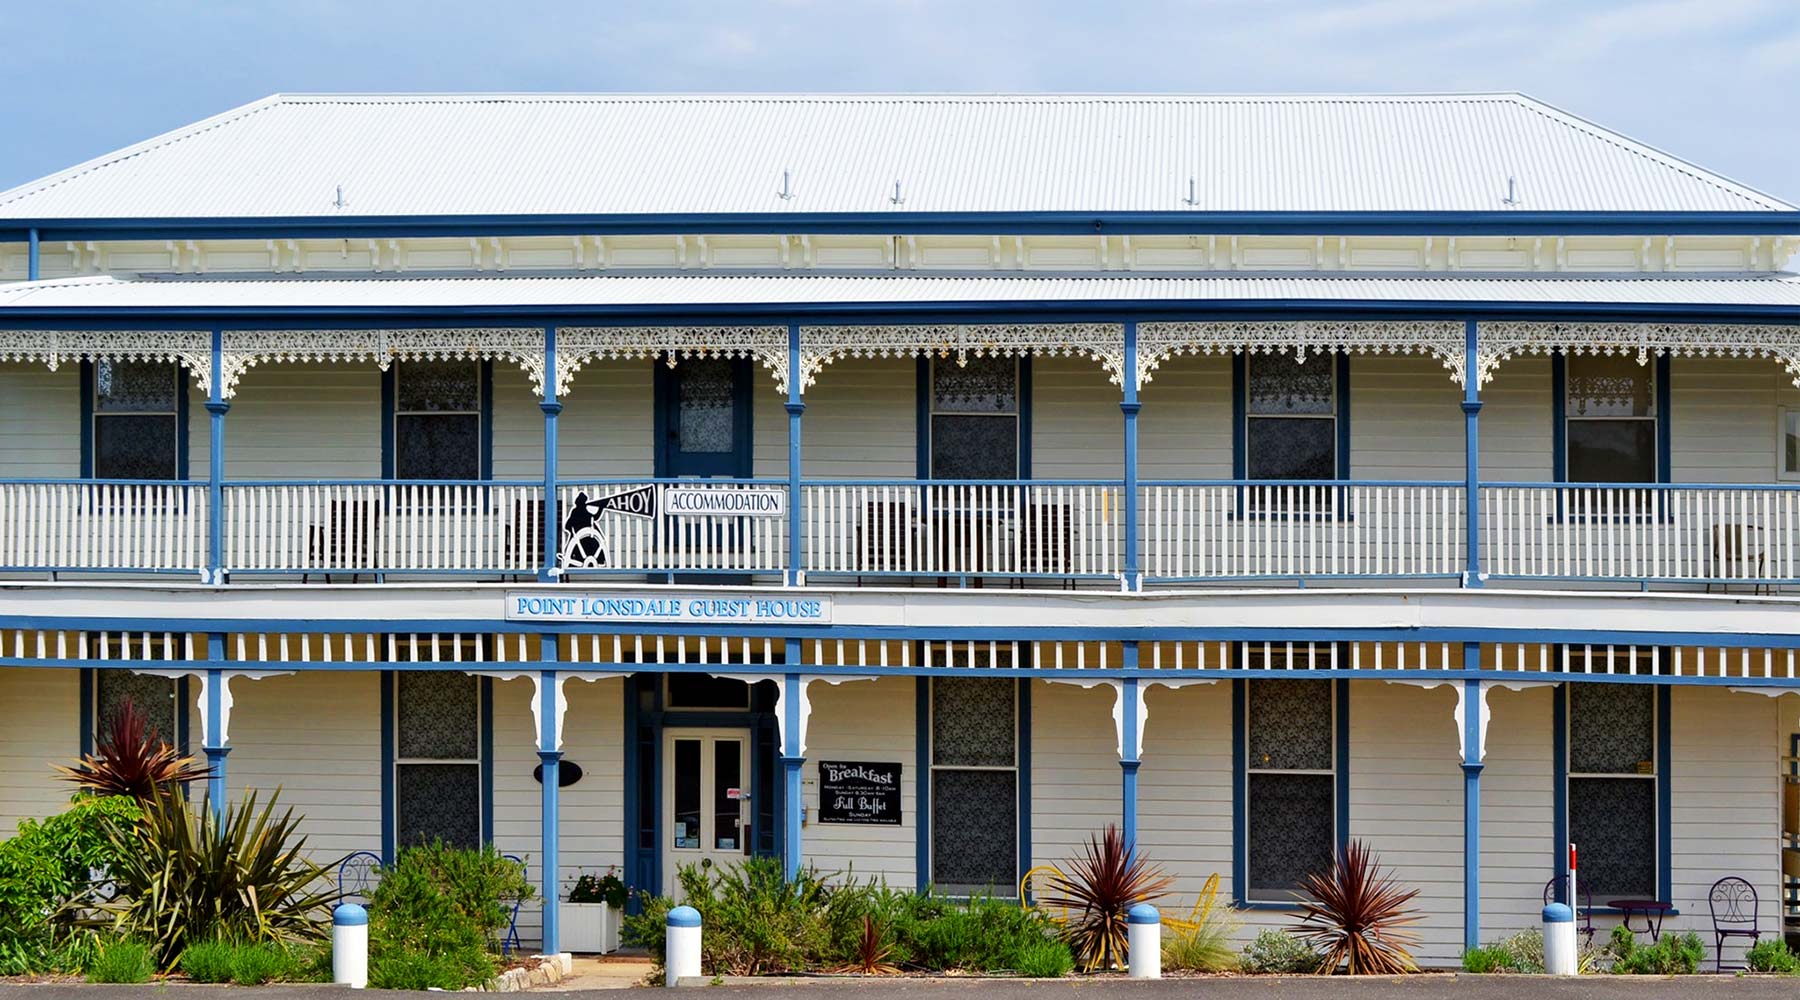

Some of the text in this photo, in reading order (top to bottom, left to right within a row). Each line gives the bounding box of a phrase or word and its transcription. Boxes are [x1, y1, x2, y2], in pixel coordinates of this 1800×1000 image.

[606, 487, 653, 513] AHOY
[671, 492, 779, 511] ACCOMMODATION
[517, 598, 822, 618] POINT LONSDALE GUEST HOUSE
[822, 763, 838, 771] Open
[829, 765, 893, 784] Breakfast
[833, 795, 886, 814] Full Buffet
